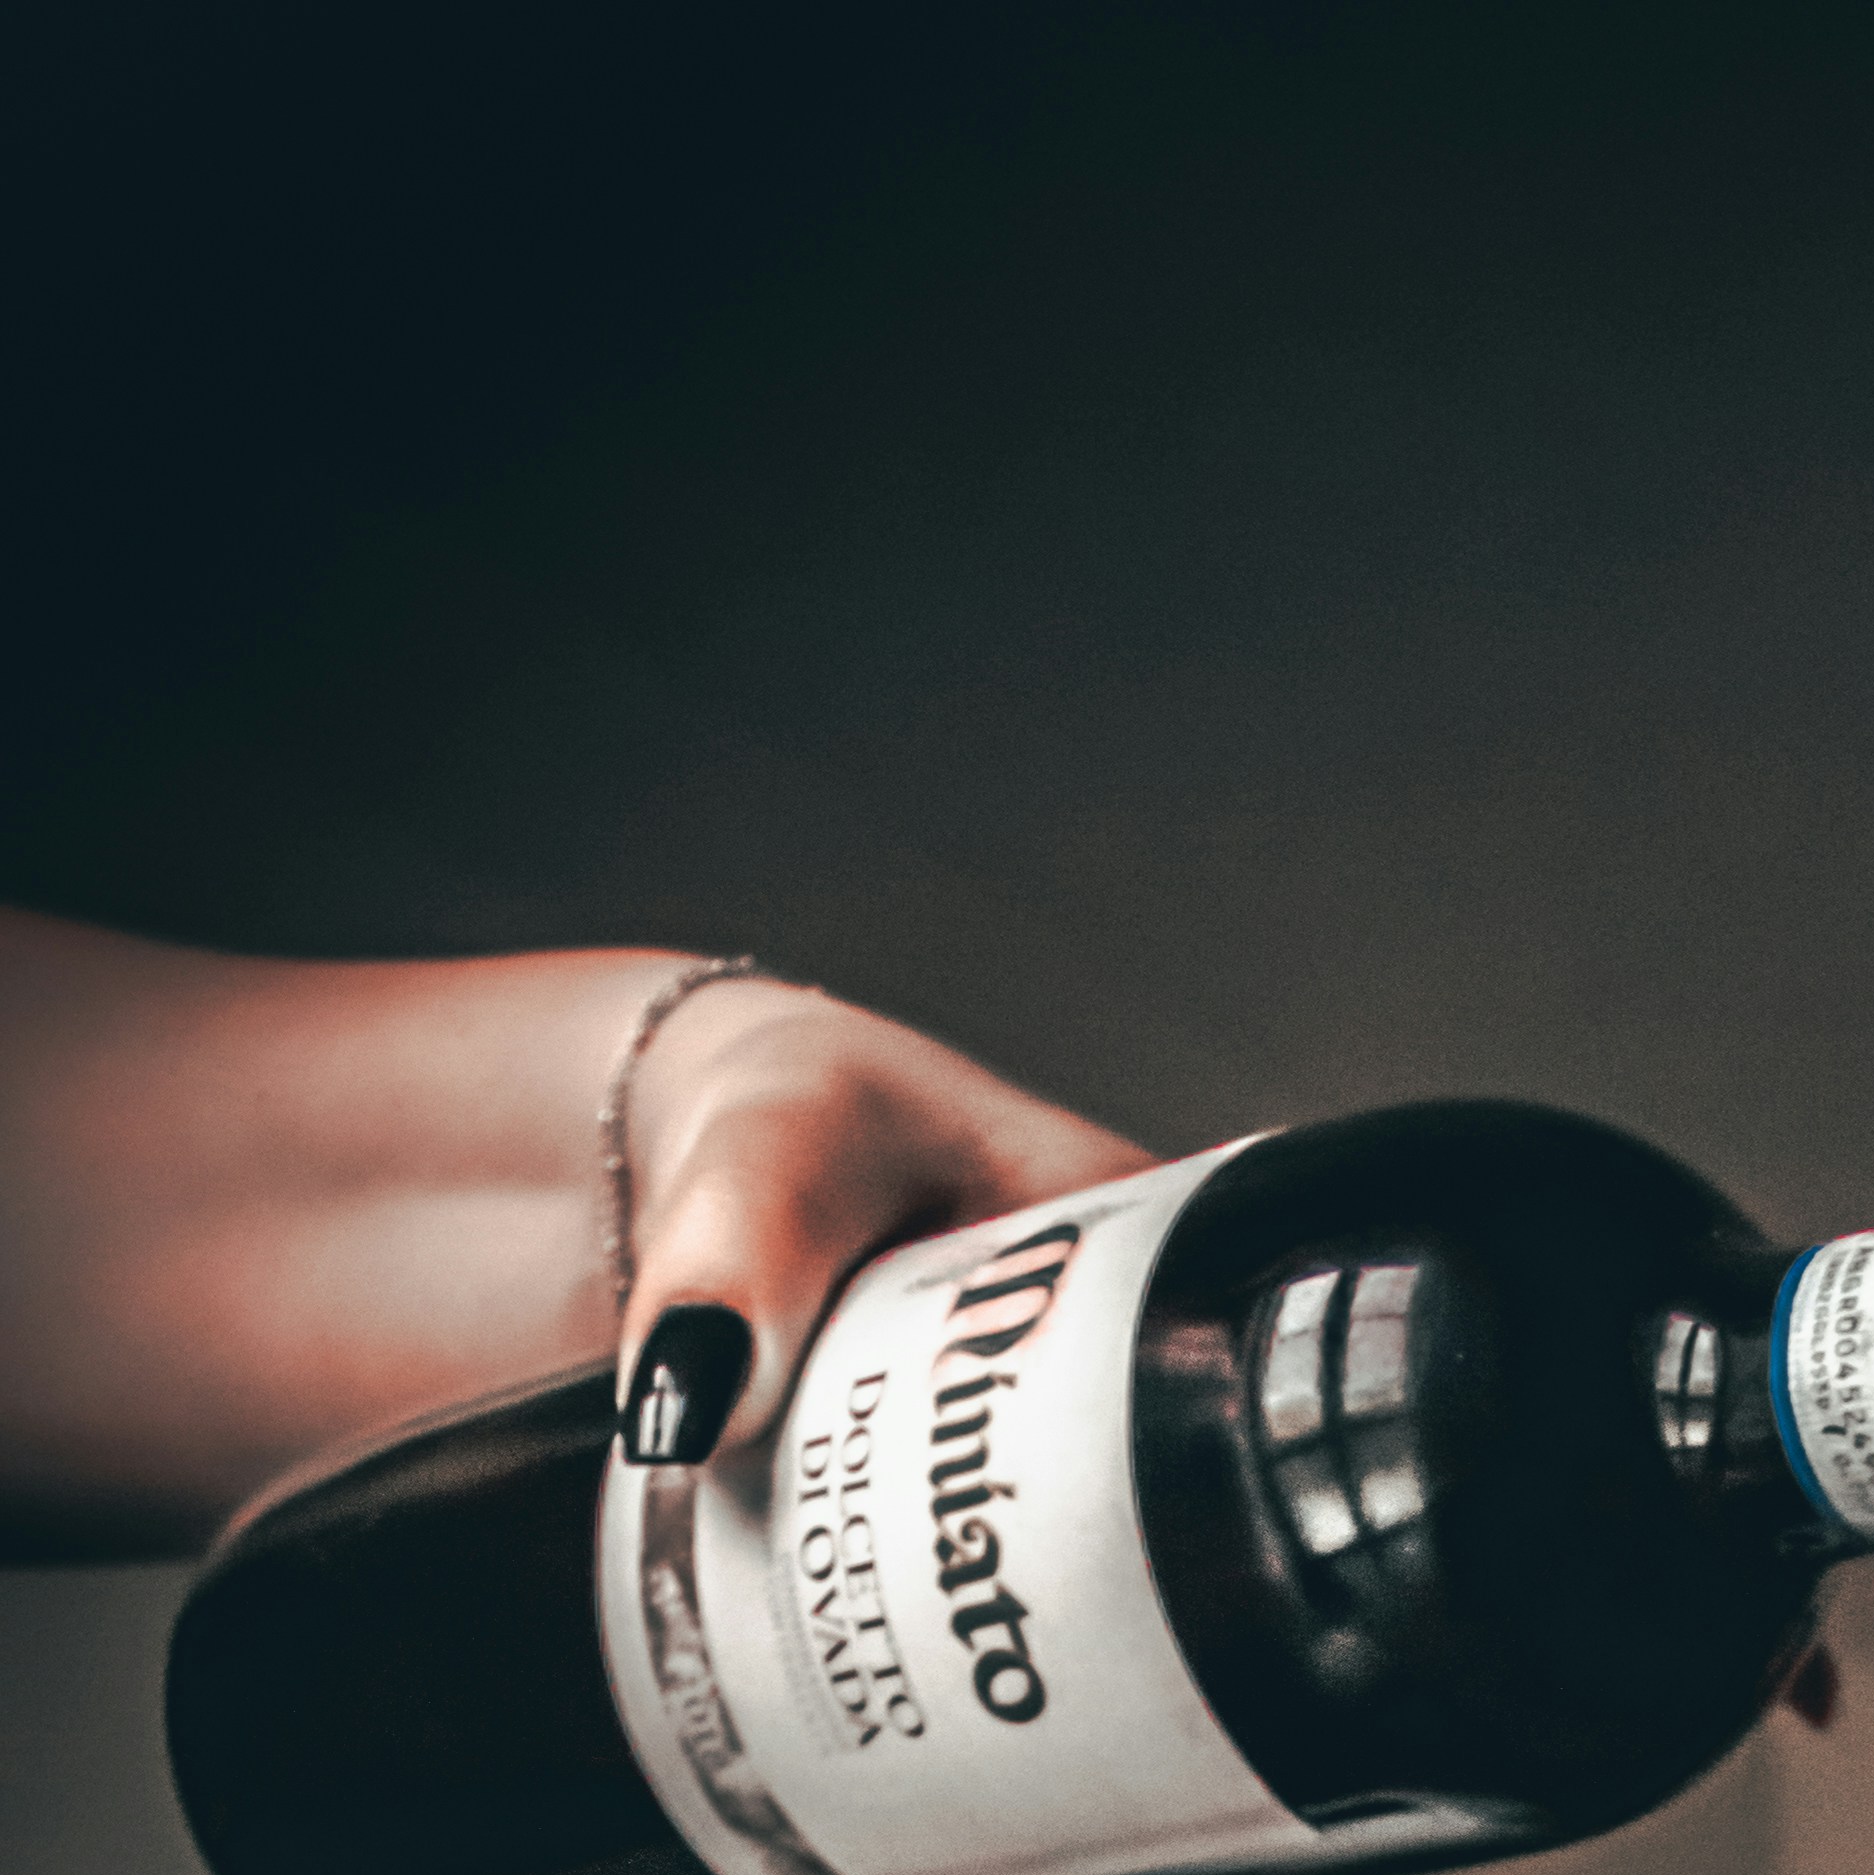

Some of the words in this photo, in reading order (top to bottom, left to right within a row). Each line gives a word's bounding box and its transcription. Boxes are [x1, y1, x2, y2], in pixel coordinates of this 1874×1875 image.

[796, 1434, 833, 1504] DI
[840, 1370, 926, 1740] DOLCETTO
[928, 1223, 1082, 1725] Miniato
[797, 1524, 883, 1749] OVADA
